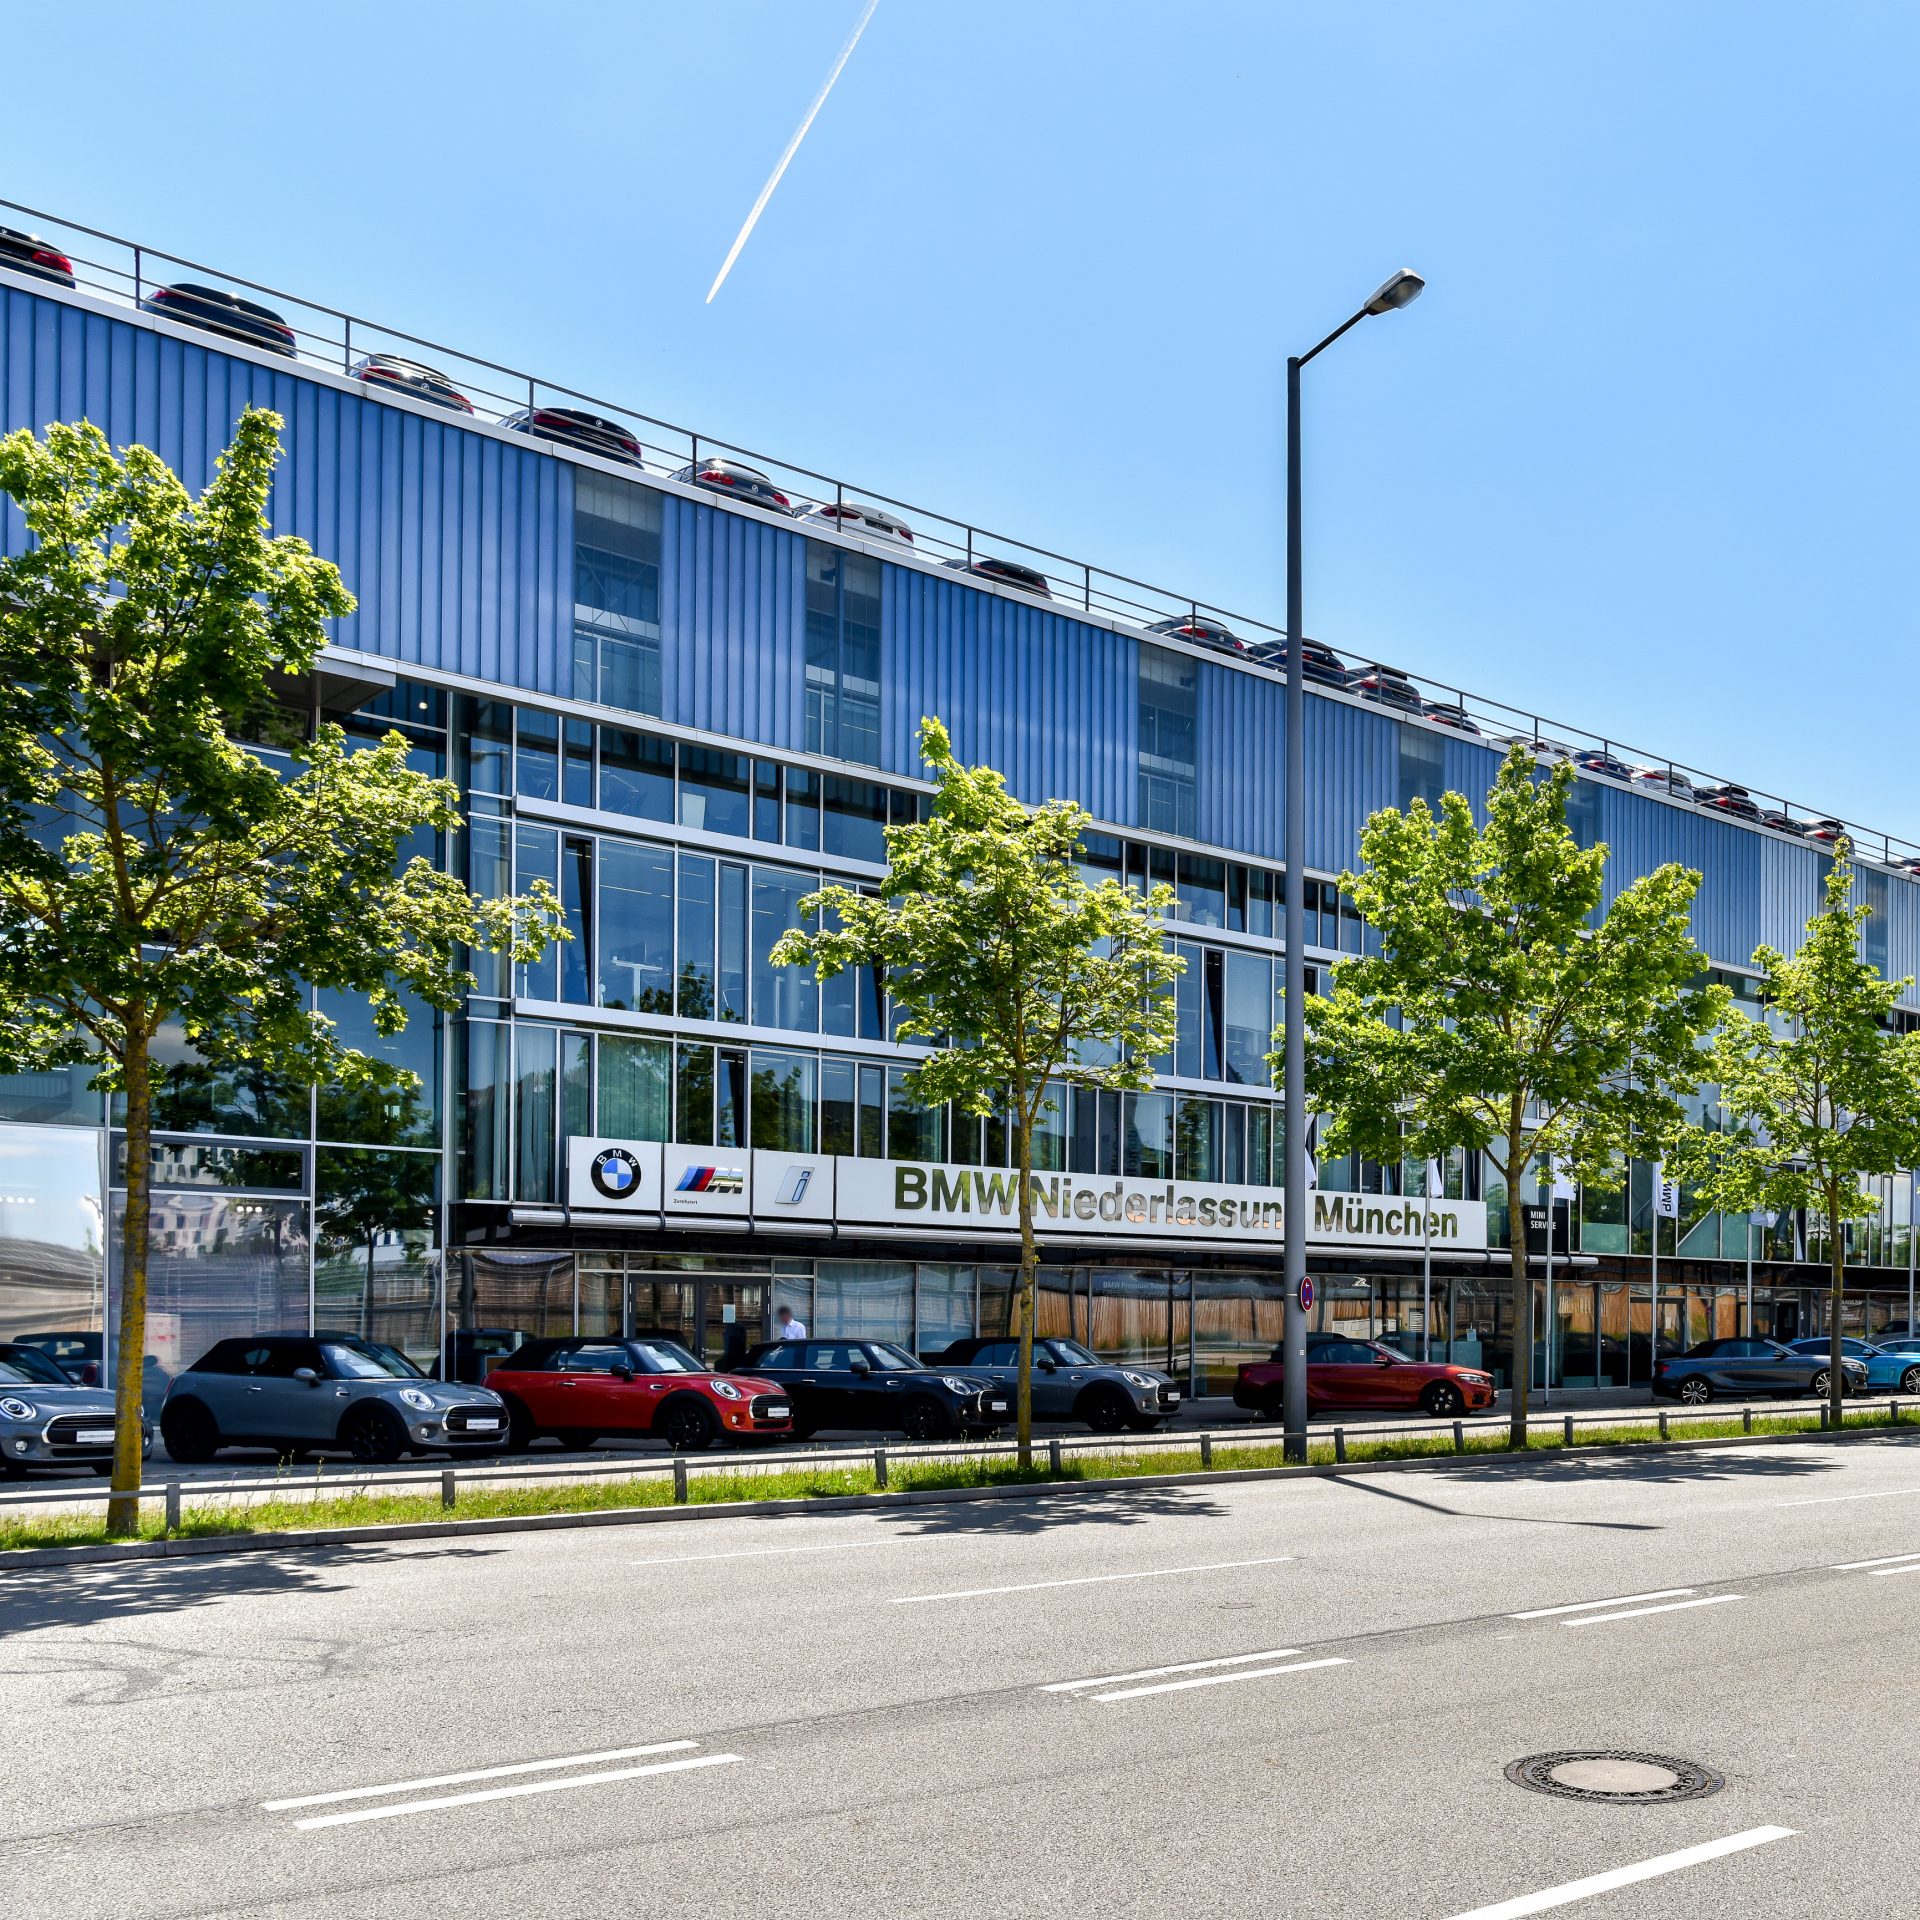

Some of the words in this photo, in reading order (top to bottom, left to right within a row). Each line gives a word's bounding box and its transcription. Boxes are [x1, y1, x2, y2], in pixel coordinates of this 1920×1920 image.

[894, 1166, 1020, 1215] BMW
[1030, 1175, 1283, 1230] Niederlassun
[1314, 1195, 1458, 1238] München
[1530, 1210, 1546, 1219] MINI
[1530, 1220, 1557, 1230] SERVIE
